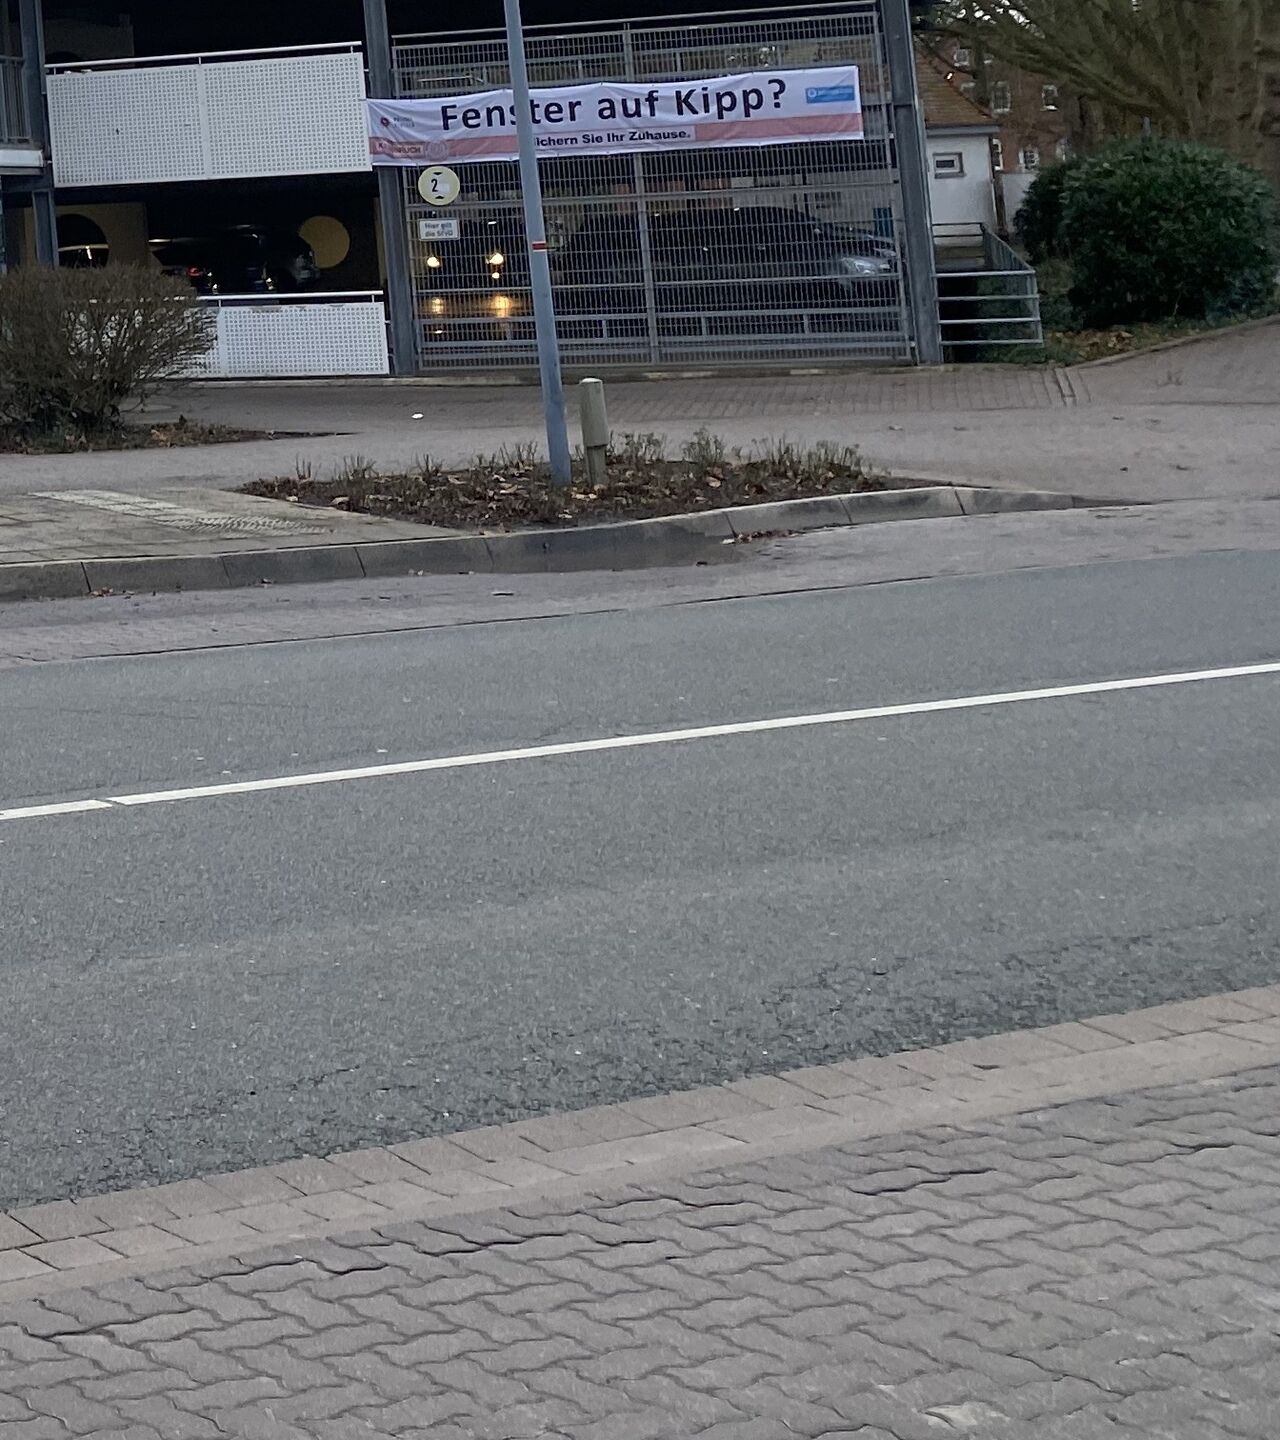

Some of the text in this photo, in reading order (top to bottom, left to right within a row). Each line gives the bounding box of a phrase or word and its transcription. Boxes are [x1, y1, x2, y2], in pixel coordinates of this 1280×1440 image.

[598, 90, 659, 120] auf
[675, 78, 787, 121] Kipp?
[534, 129, 691, 147] ichern Sie Ihr Zuhause.
